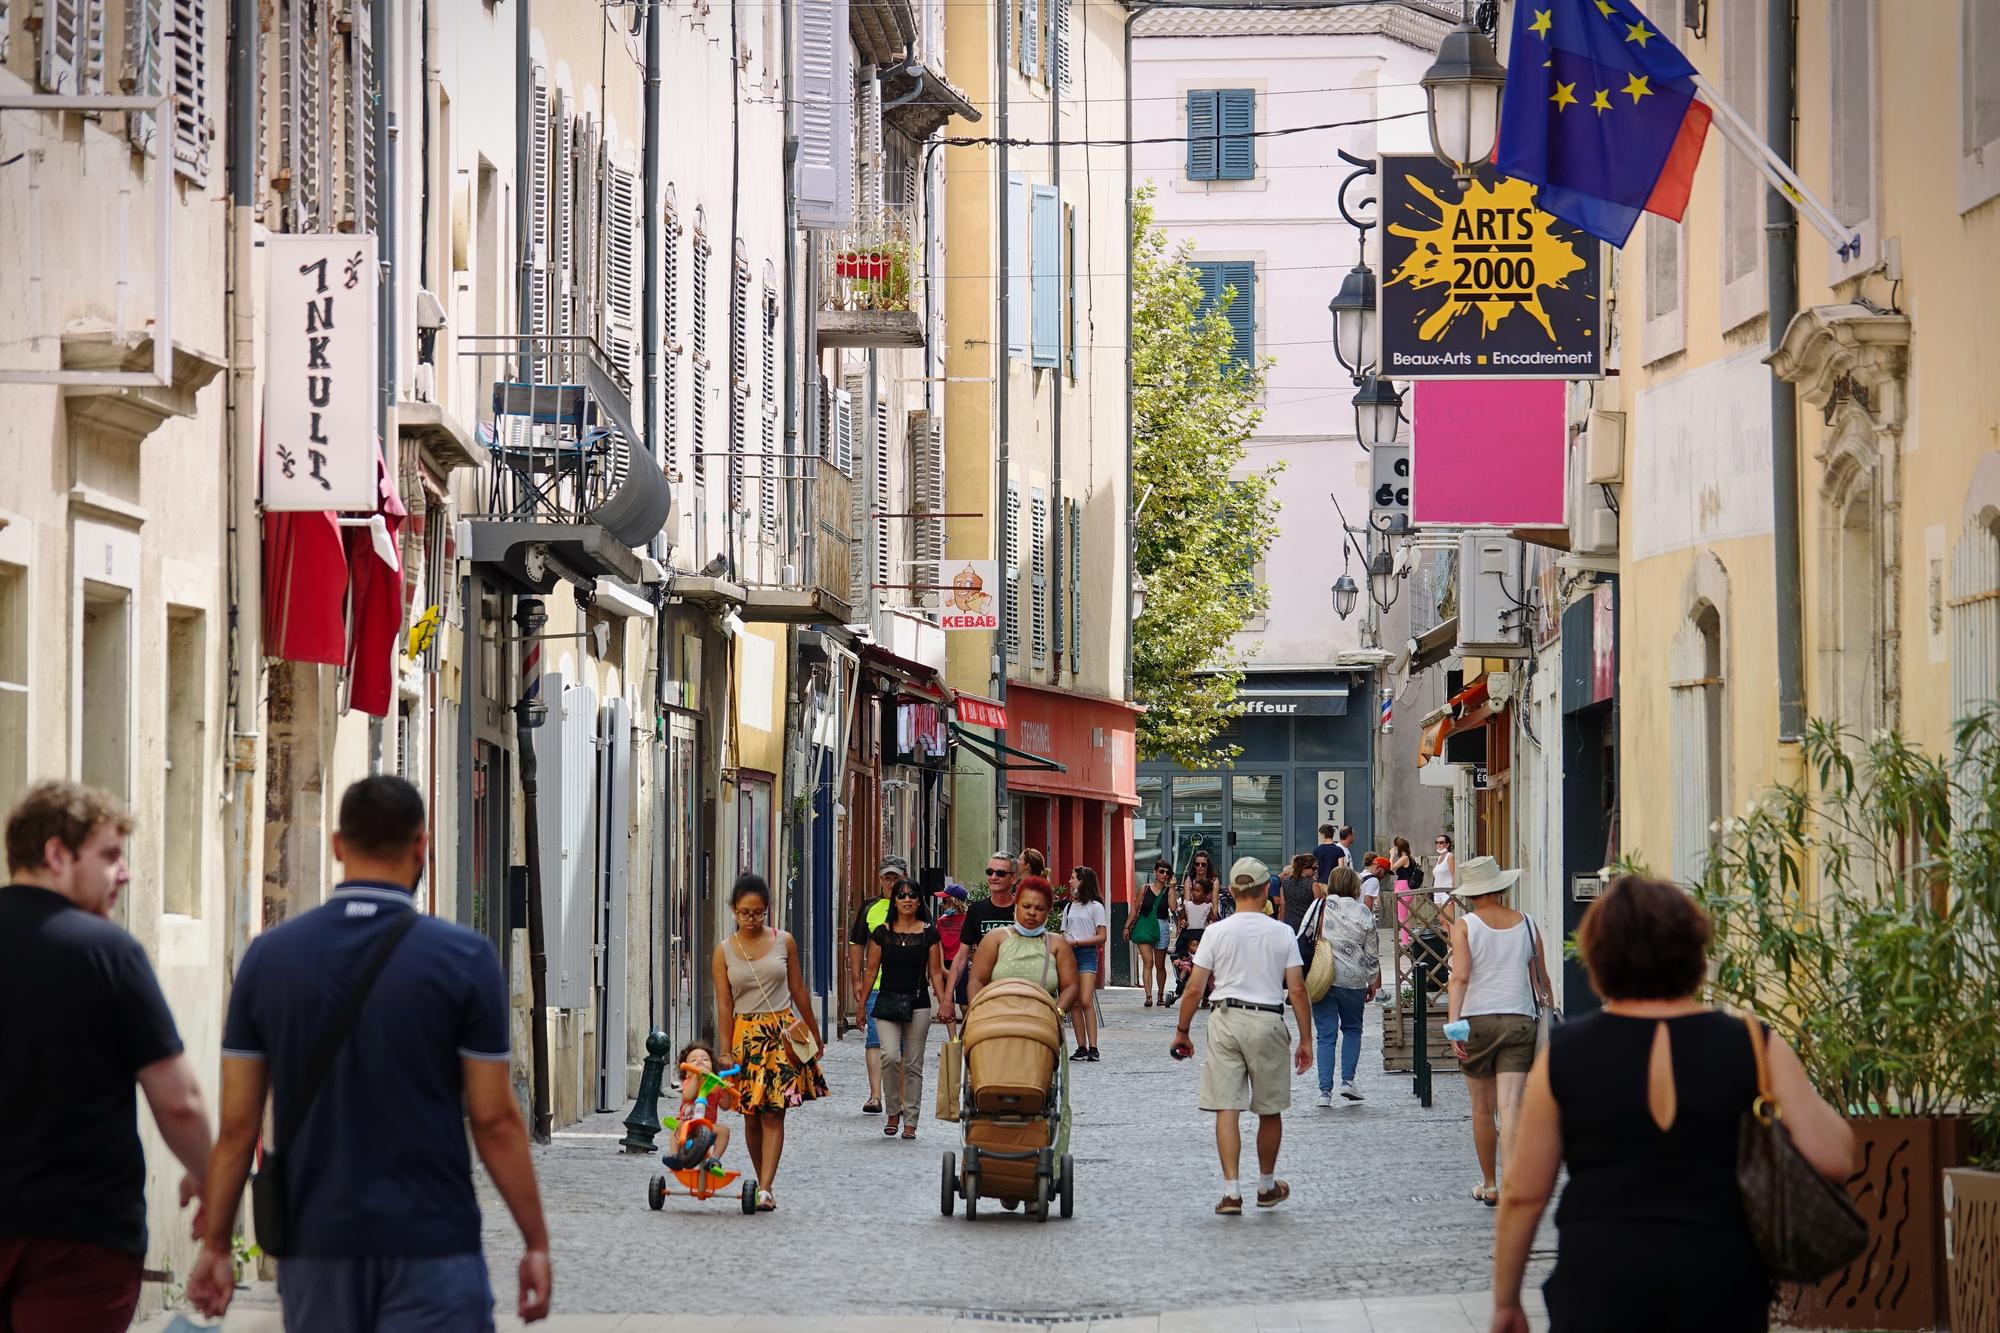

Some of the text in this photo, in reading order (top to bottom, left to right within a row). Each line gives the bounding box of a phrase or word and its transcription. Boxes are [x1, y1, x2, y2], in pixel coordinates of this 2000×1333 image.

[1452, 207, 1534, 241] ARTS
[1453, 257, 1536, 290] 2000
[1392, 350, 1593, 366] Beaux-Arts Encadrement
[942, 615, 997, 628] KEBAB
